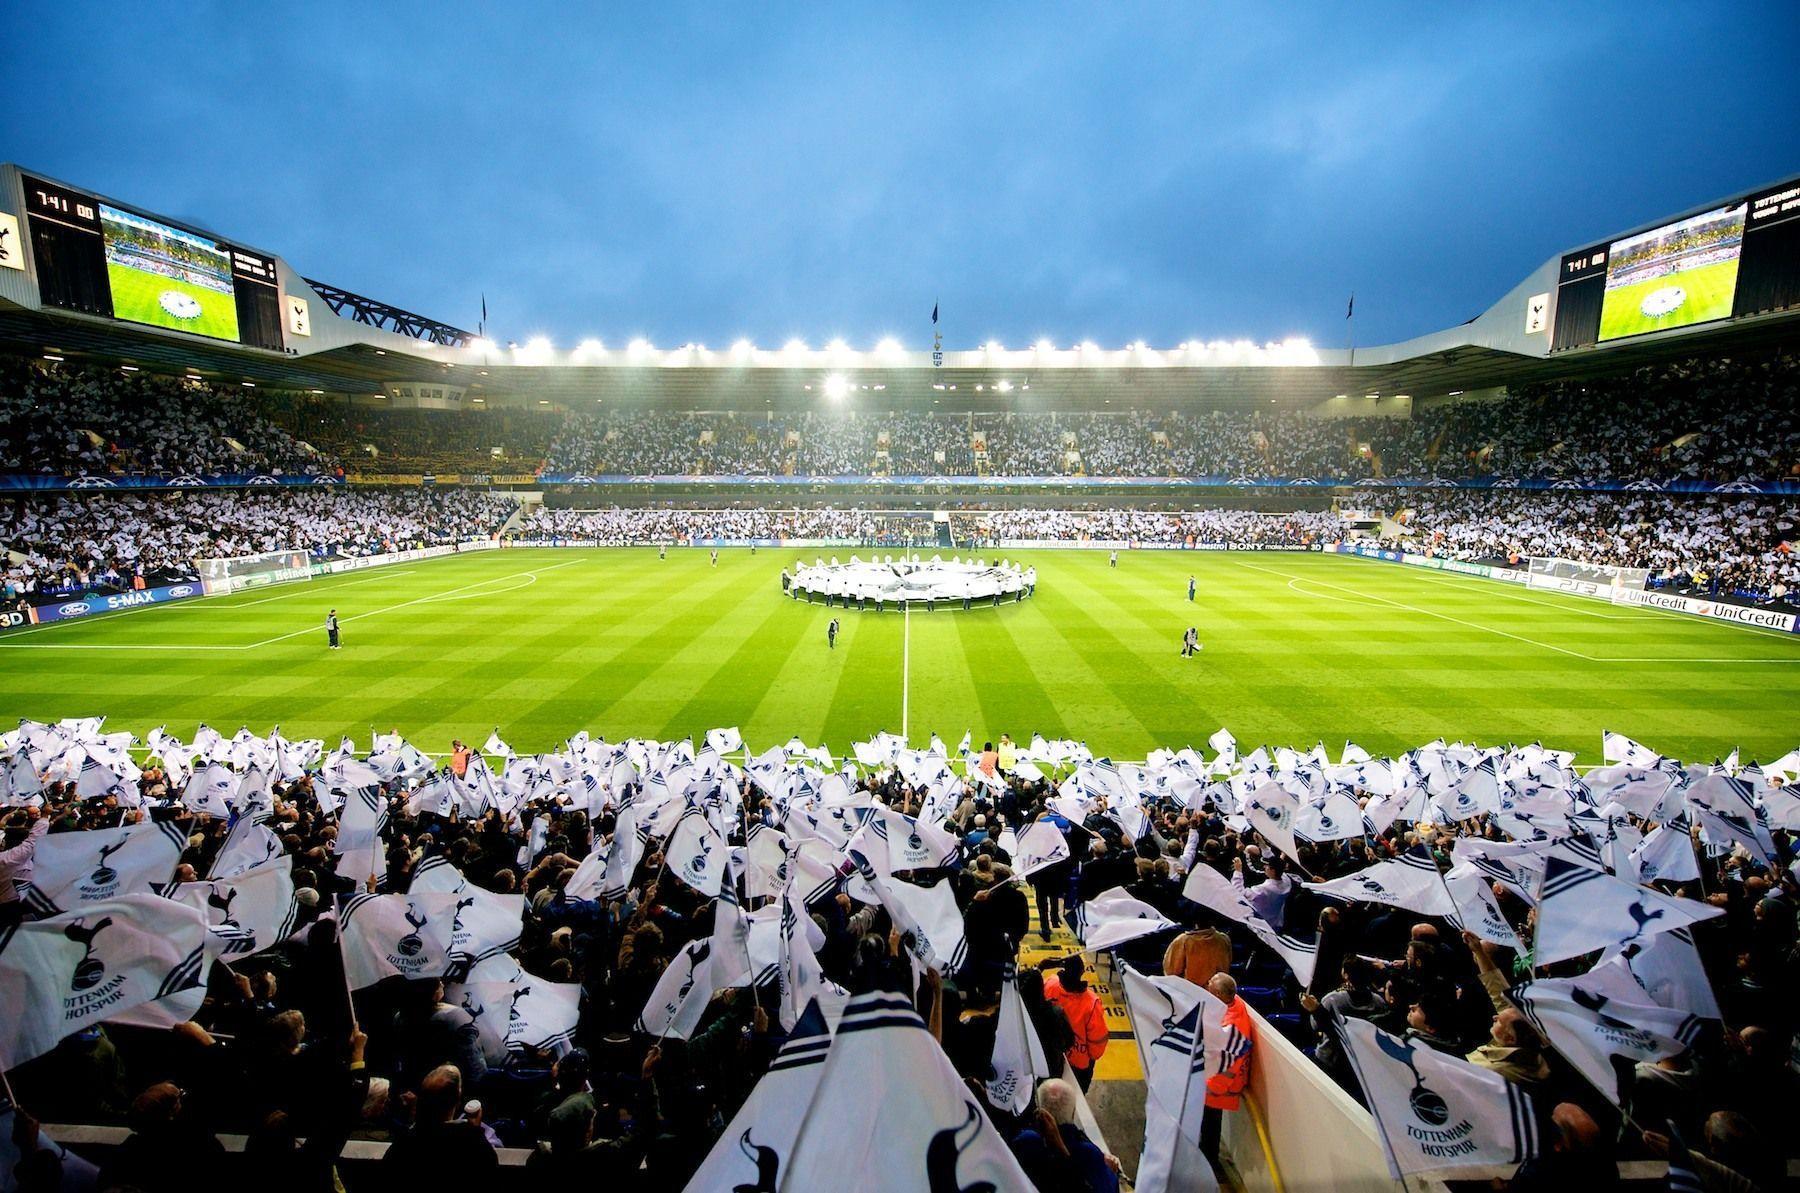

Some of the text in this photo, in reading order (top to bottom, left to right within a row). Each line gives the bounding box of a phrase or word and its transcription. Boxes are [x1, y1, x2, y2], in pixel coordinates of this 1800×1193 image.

[1141, 542, 1183, 550] MasterCard
[343, 558, 370, 569] PS3
[1559, 580, 1598, 594] PS3
[108, 590, 155, 609] S-MAX
[1629, 591, 1688, 610] UniCredit
[0, 612, 24, 628] 3D
[1714, 604, 1788, 628] UniCredit
[63, 974, 127, 1008] OTTENHAM
[65, 990, 125, 1020] HOTSPUR
[1104, 1006, 1125, 1017] 16
[1407, 1119, 1473, 1142] TOTTENHAM
[1421, 1139, 1477, 1158] HOTSPUR
